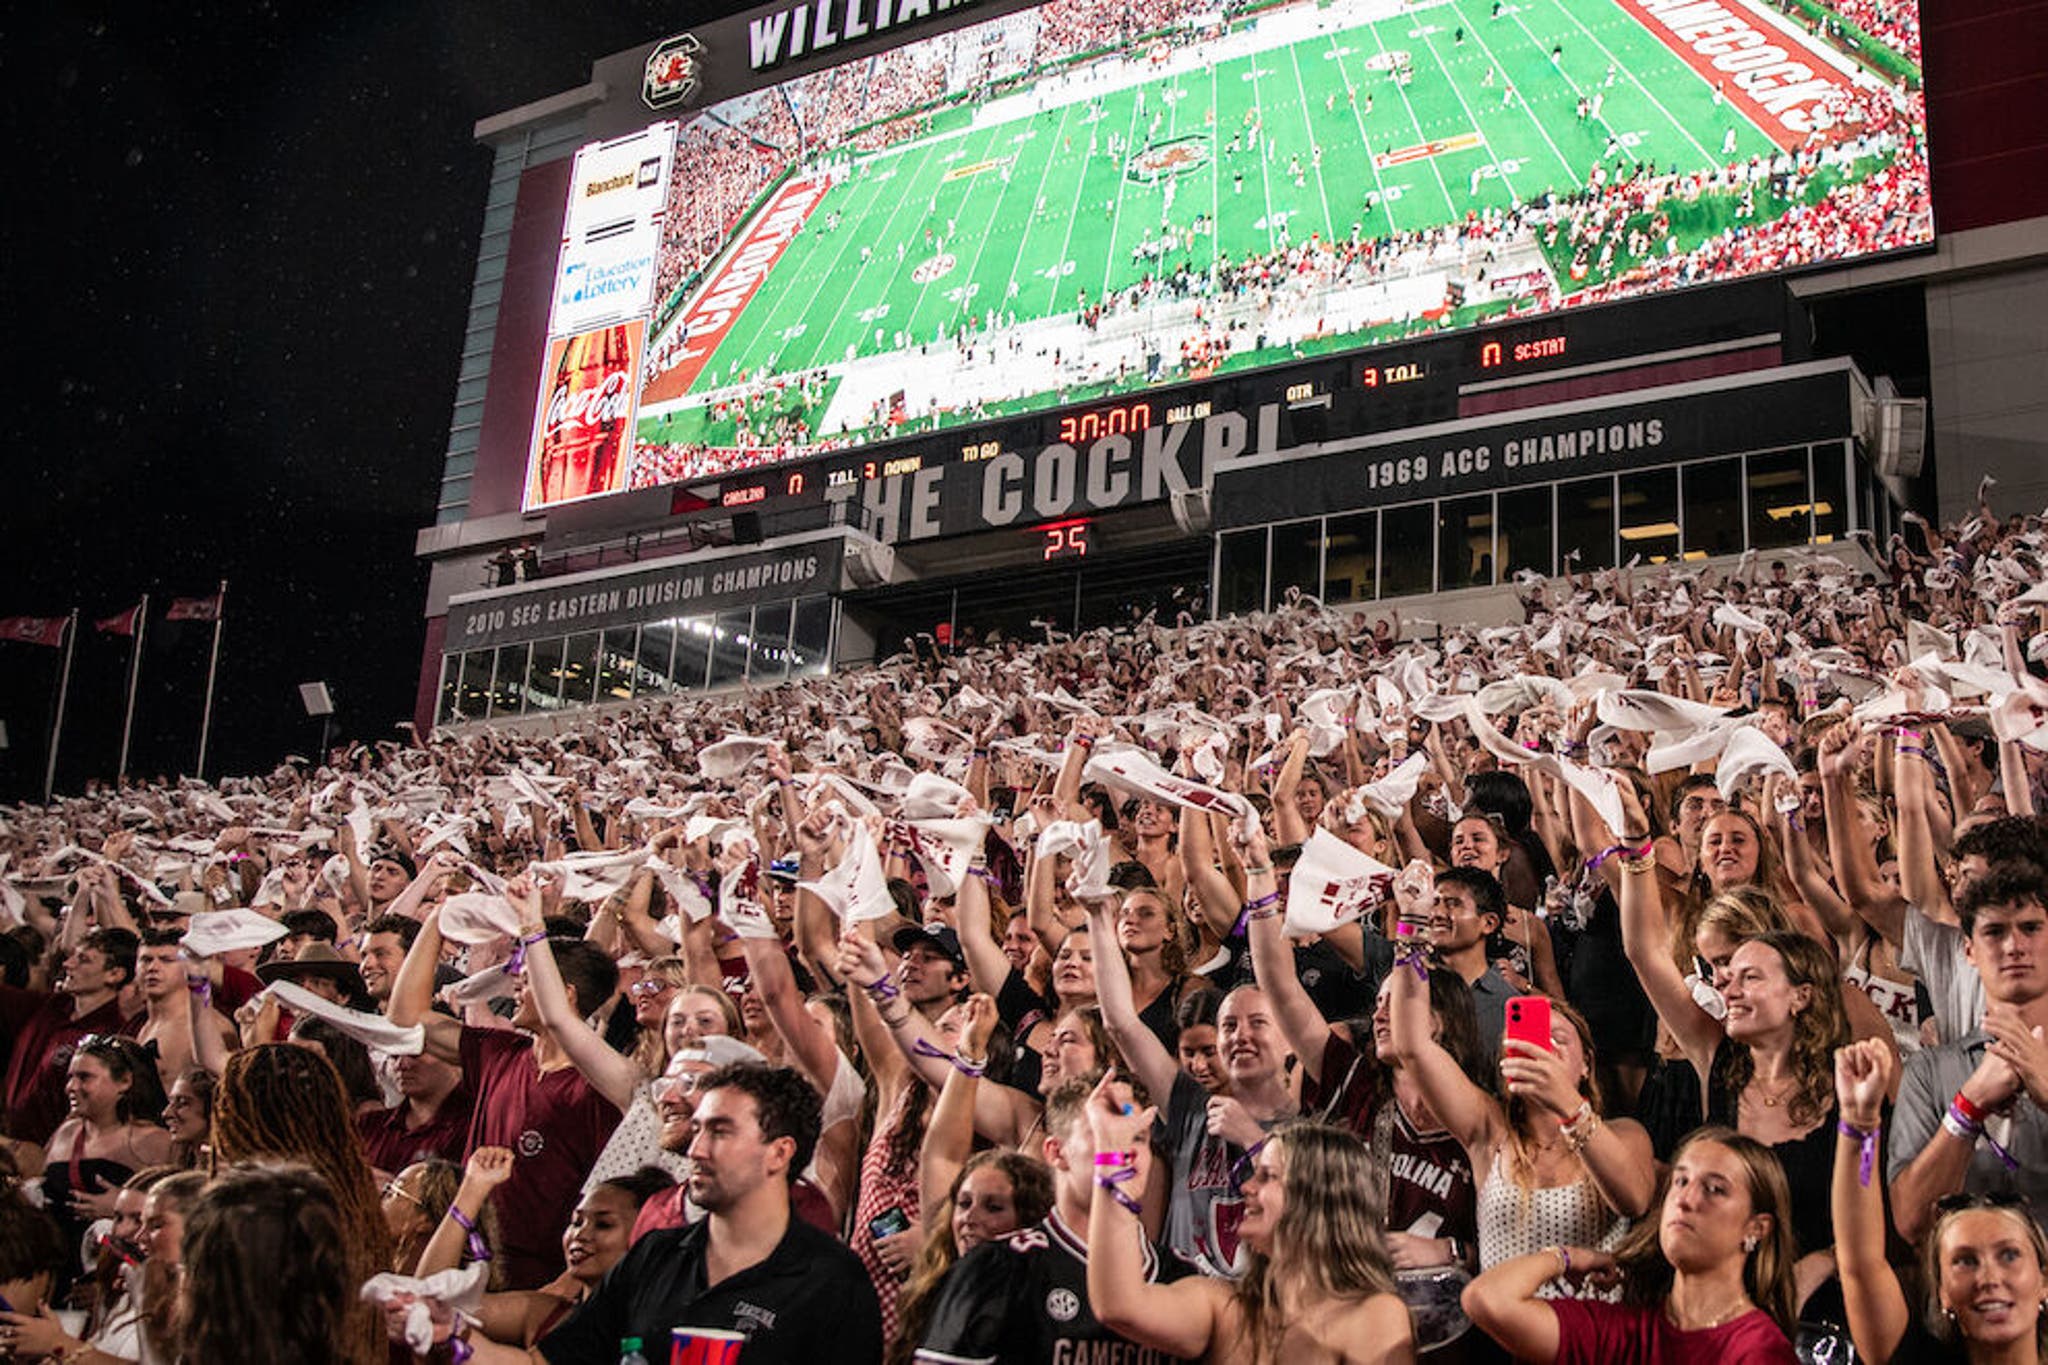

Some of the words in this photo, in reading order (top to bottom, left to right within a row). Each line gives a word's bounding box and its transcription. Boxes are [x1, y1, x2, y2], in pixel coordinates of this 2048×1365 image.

[1167, 406, 1193, 424] BALL
[1194, 403, 1211, 418] ON
[962, 445, 979, 462] TO
[980, 441, 1000, 460] GO
[1367, 457, 1429, 489] 1969
[1441, 446, 1490, 478] ACC
[1504, 419, 1663, 468] CHAMPIONS
[824, 465, 944, 545] THE
[466, 611, 504, 636] 2010
[511, 604, 541, 627] SEC
[548, 590, 621, 622] EASTERN
[626, 576, 704, 607] DIVISION
[711, 556, 818, 595] CHAMPIONS
[1390, 1153, 1454, 1199] OLINA
